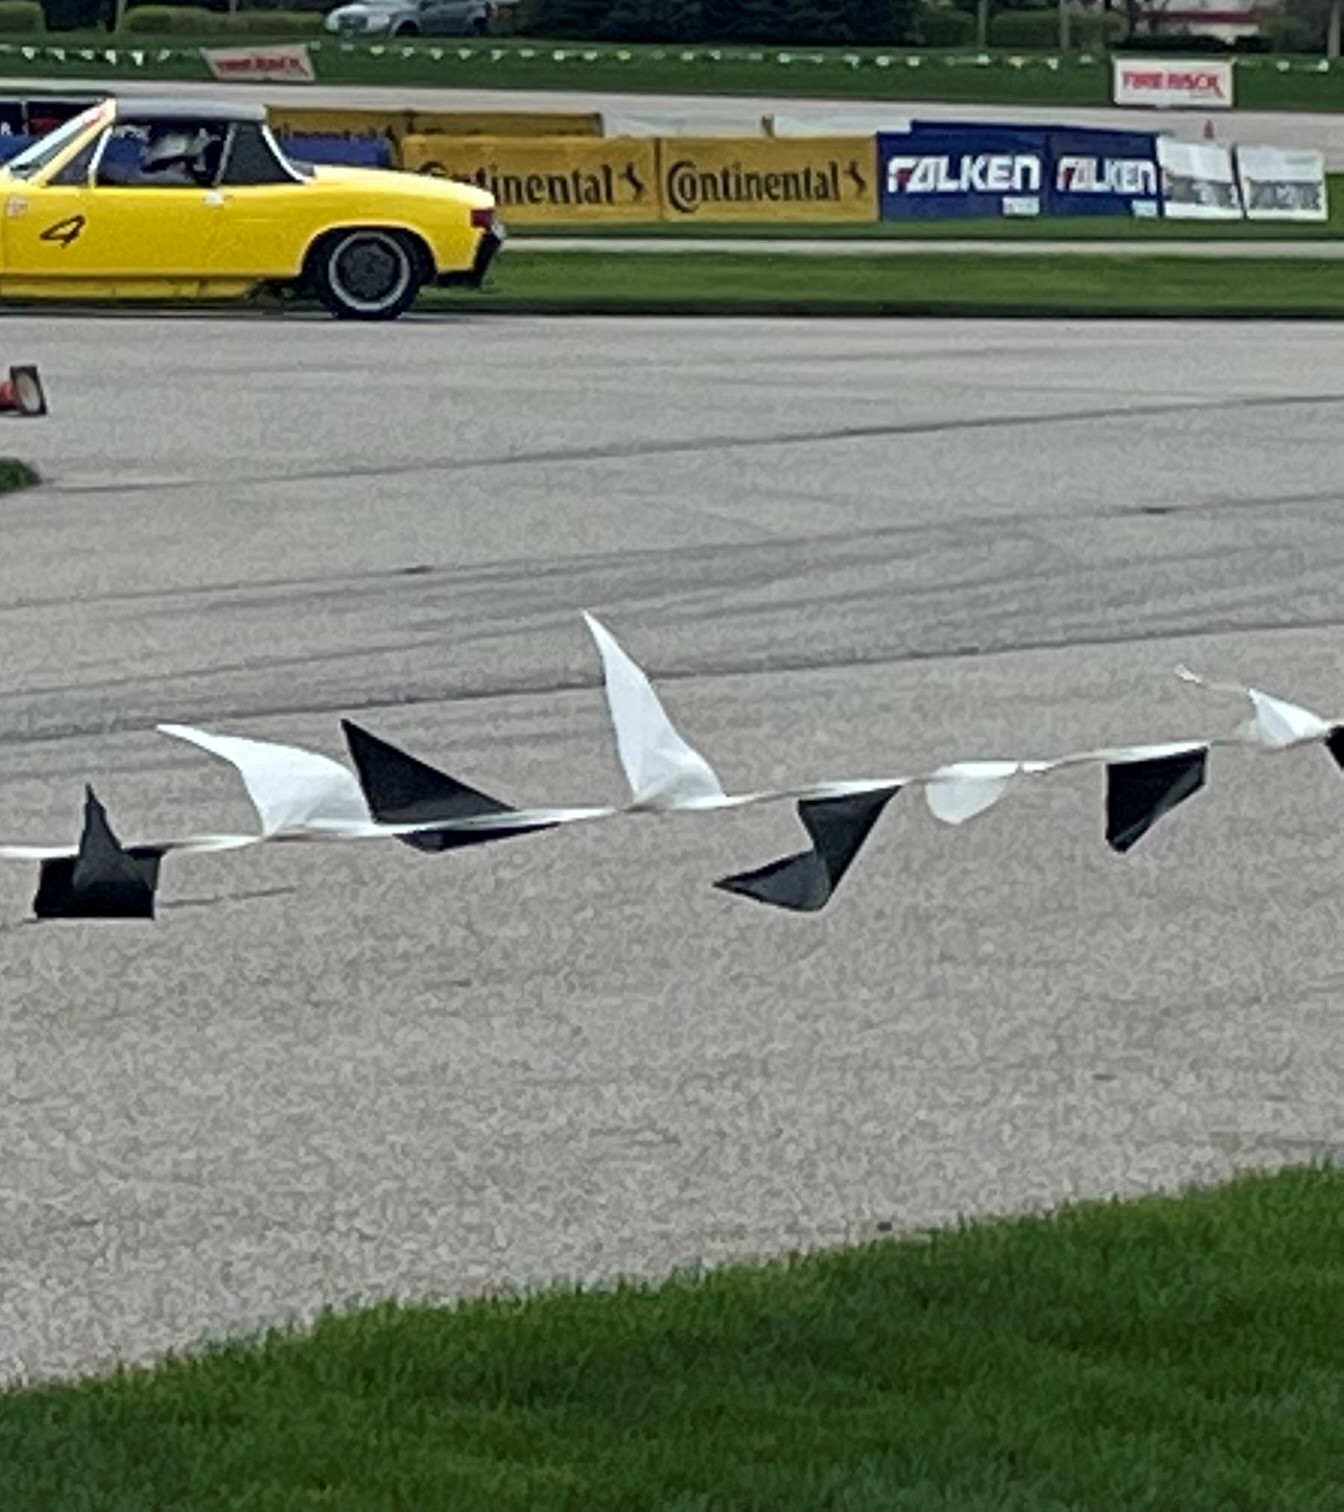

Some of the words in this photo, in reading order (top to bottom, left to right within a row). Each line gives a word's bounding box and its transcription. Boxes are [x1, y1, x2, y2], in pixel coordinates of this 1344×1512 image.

[668, 160, 842, 214] Continental
[887, 154, 1041, 192] FALKEN
[1057, 156, 1158, 196] FALKEN
[39, 214, 86, 249] 4
